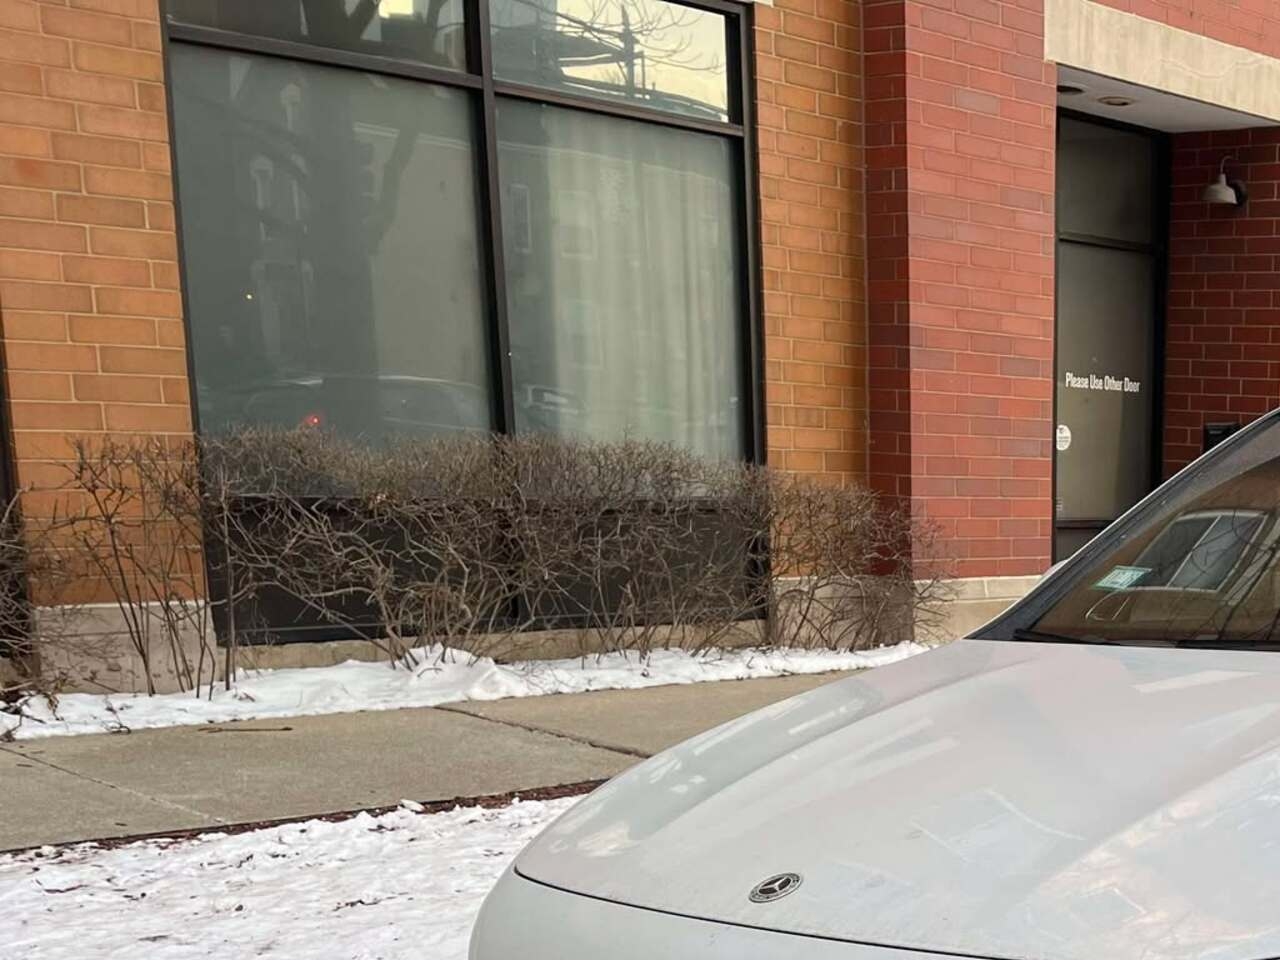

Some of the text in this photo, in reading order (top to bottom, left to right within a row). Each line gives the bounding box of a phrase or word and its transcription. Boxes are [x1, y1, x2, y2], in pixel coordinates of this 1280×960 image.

[1065, 372, 1140, 393] Please Use Other Door
